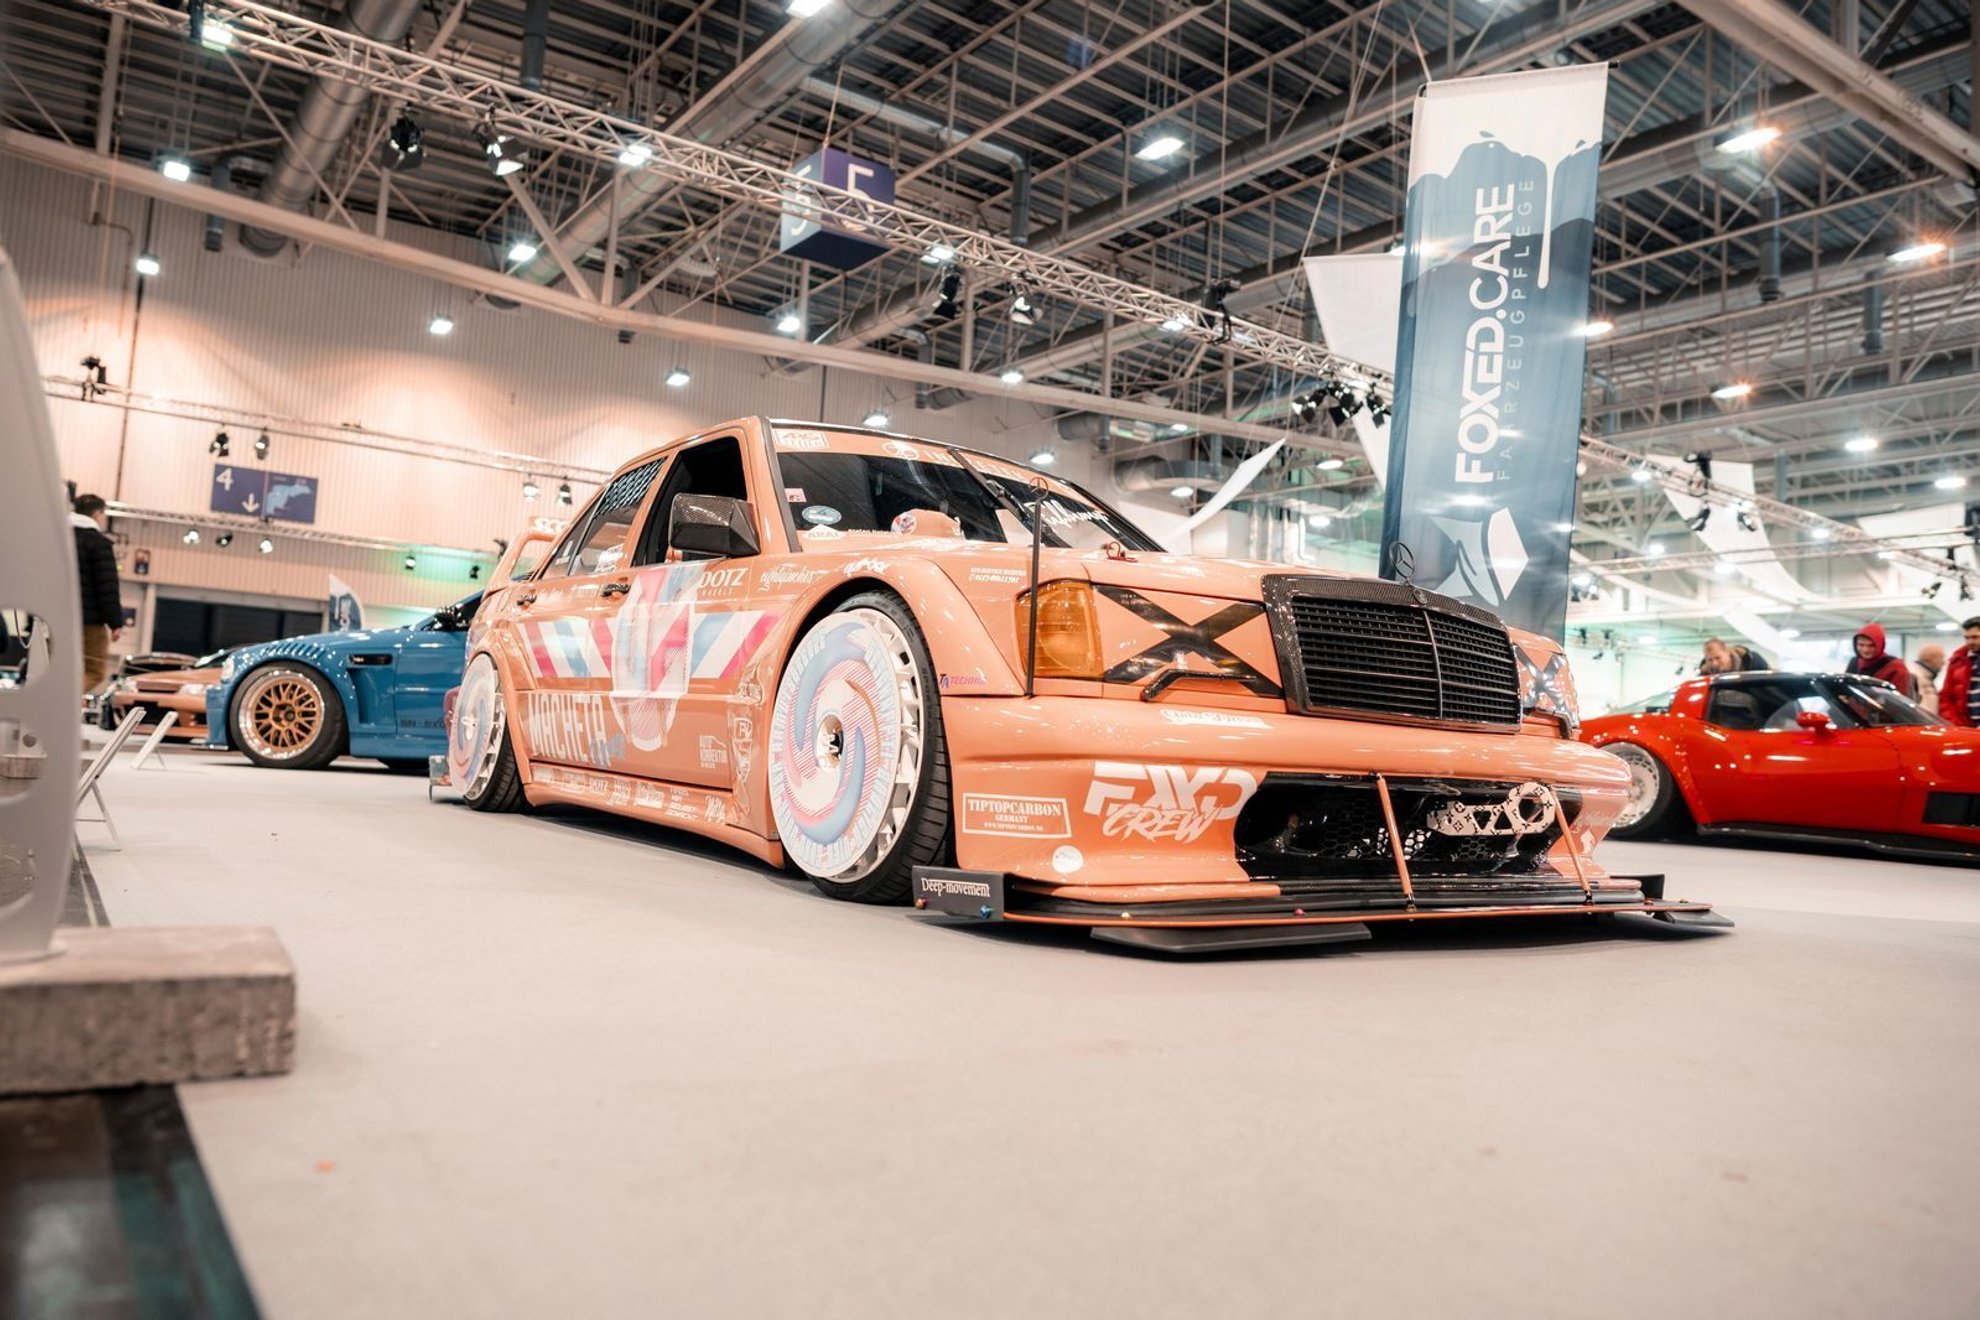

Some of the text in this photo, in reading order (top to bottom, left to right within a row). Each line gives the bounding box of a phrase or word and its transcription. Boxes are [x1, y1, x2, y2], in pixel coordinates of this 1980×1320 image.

[1454, 183, 1515, 484] FOXED.CARE
[215, 468, 234, 491] 4
[697, 567, 750, 589] DOTZ
[968, 799, 1062, 817] TIPTOPCARBON
[994, 813, 1029, 824] GERMANY
[1102, 803, 1223, 844] CREW
[921, 877, 991, 898] Deep-movement
